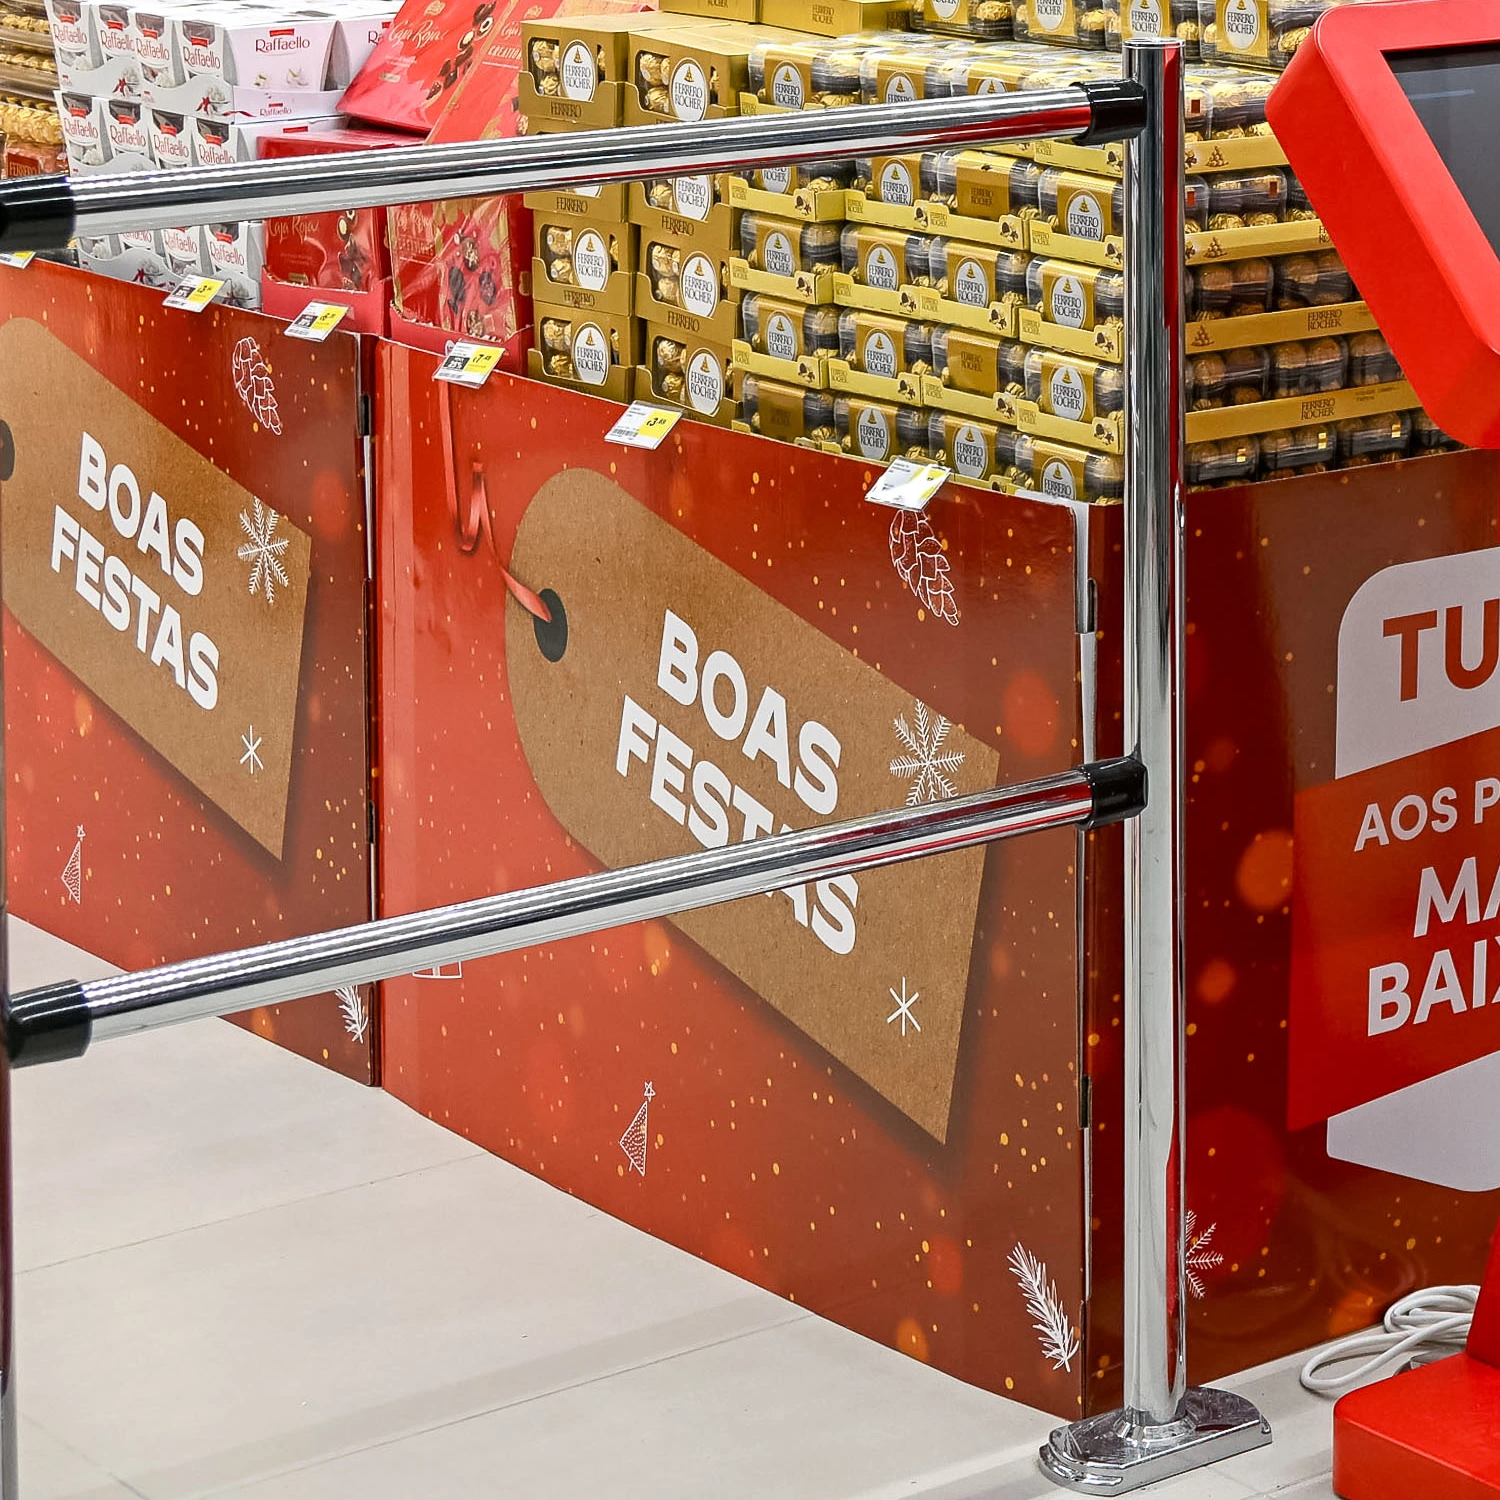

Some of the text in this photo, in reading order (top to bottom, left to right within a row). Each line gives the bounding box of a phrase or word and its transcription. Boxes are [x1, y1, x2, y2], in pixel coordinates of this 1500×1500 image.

[1227, 10, 1256, 24] FERRERO
[53, 25, 88, 45] Raffaello
[1227, 21, 1256, 36] ROCHER
[135, 38, 170, 61] Raffaello
[255, 36, 311, 53] Raffaello
[183, 45, 221, 70] Raffaello
[565, 63, 592, 78] FERRERO
[565, 75, 592, 92] ROCHER
[773, 82, 801, 97] FERRERO
[773, 93, 800, 109] ROCHER
[550, 103, 583, 119] FERRERO
[64, 118, 99, 140] Raffaello
[153, 134, 190, 159] Raffaello
[556, 197, 589, 214] FERRERO
[661, 215, 695, 237] FERRERO
[1070, 211, 1099, 228] FERRERO
[1069, 224, 1099, 240] ROCHER
[210, 241, 245, 266] Raffaello
[766, 248, 791, 263] FERRERO
[766, 261, 791, 275] ROCHER
[668, 311, 700, 332] FERRERO
[1308, 309, 1342, 323] FERRERO
[1308, 318, 1342, 332] ROCHER
[690, 371, 720, 388] FERRERO
[689, 383, 719, 400] ROCHER
[78, 431, 206, 597] BOAS
[50, 505, 220, 711] FESTAS
[656, 609, 842, 815] BOAS
[1353, 787, 1458, 853] AOS
